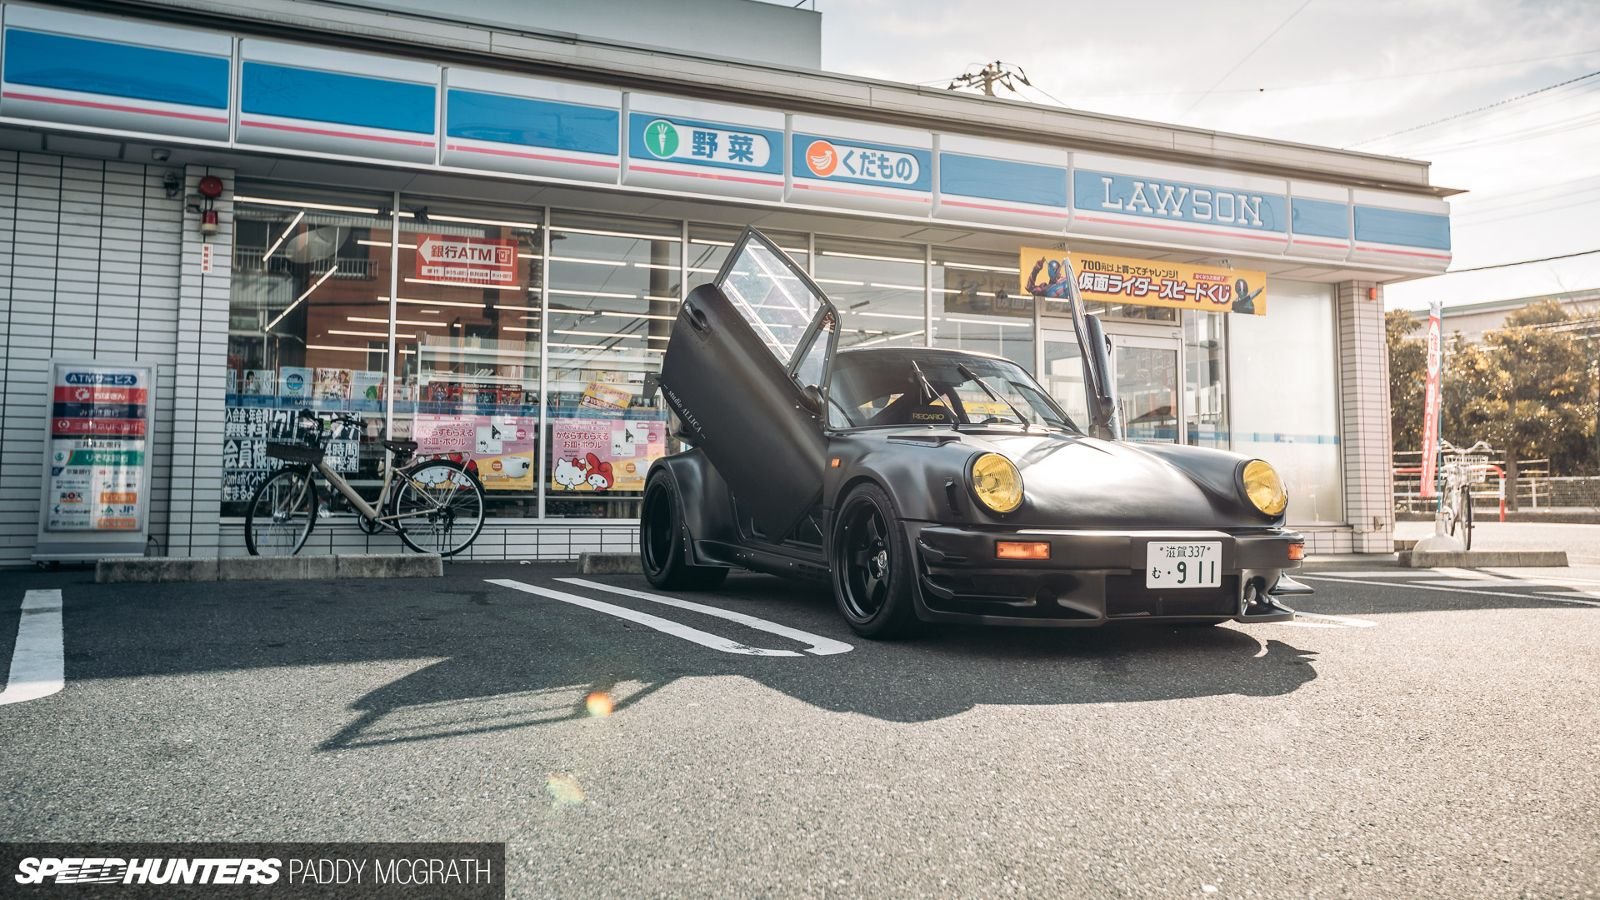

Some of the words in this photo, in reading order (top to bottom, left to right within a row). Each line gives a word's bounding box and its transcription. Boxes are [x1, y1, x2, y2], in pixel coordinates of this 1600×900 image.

[841, 150, 913, 181] くだもの
[1102, 177, 1264, 227] LAWSON
[431, 244, 492, 262] 銀行ATM
[1078, 271, 1231, 304] 仮面ライダースピードくじ
[69, 374, 134, 384] ATMサービス
[912, 412, 945, 421] RECARO
[556, 431, 609, 441] かならずもらえる
[320, 441, 358, 457] 4時間
[1152, 567, 1161, 579] む
